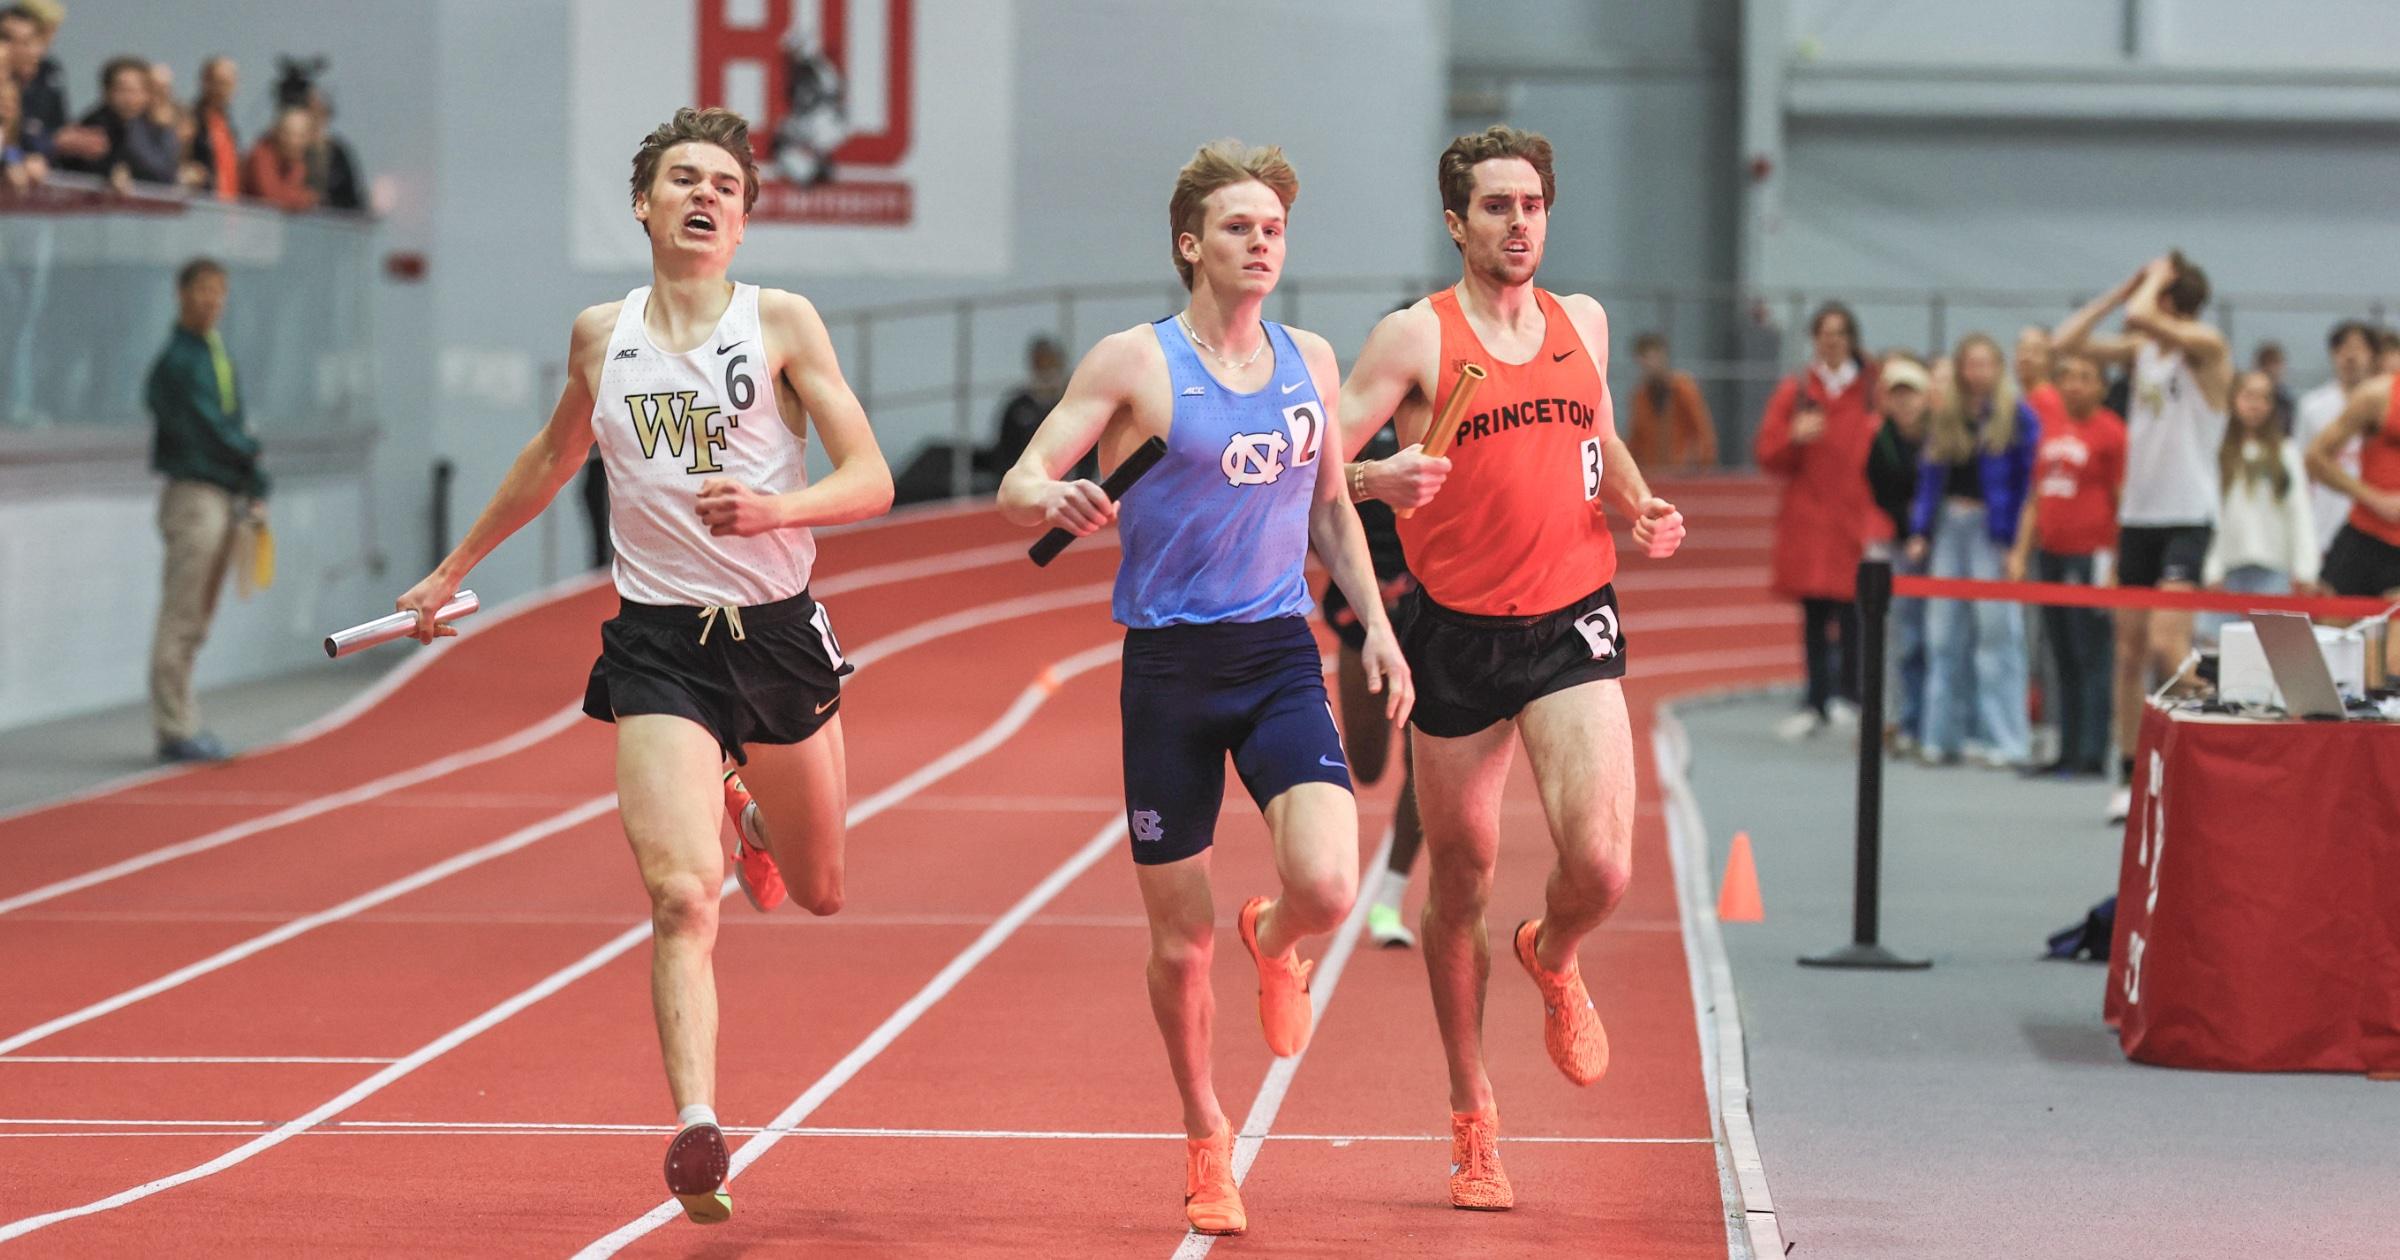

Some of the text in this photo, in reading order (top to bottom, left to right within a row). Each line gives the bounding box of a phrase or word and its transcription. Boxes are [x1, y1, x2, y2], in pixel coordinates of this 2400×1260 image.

[613, 348, 639, 360] ACC
[725, 354, 756, 411] 6
[1293, 407, 1316, 463] 2
[1455, 398, 1595, 447] PRINCETON
[1587, 441, 1600, 497] 3
[1583, 613, 1614, 661] 3
